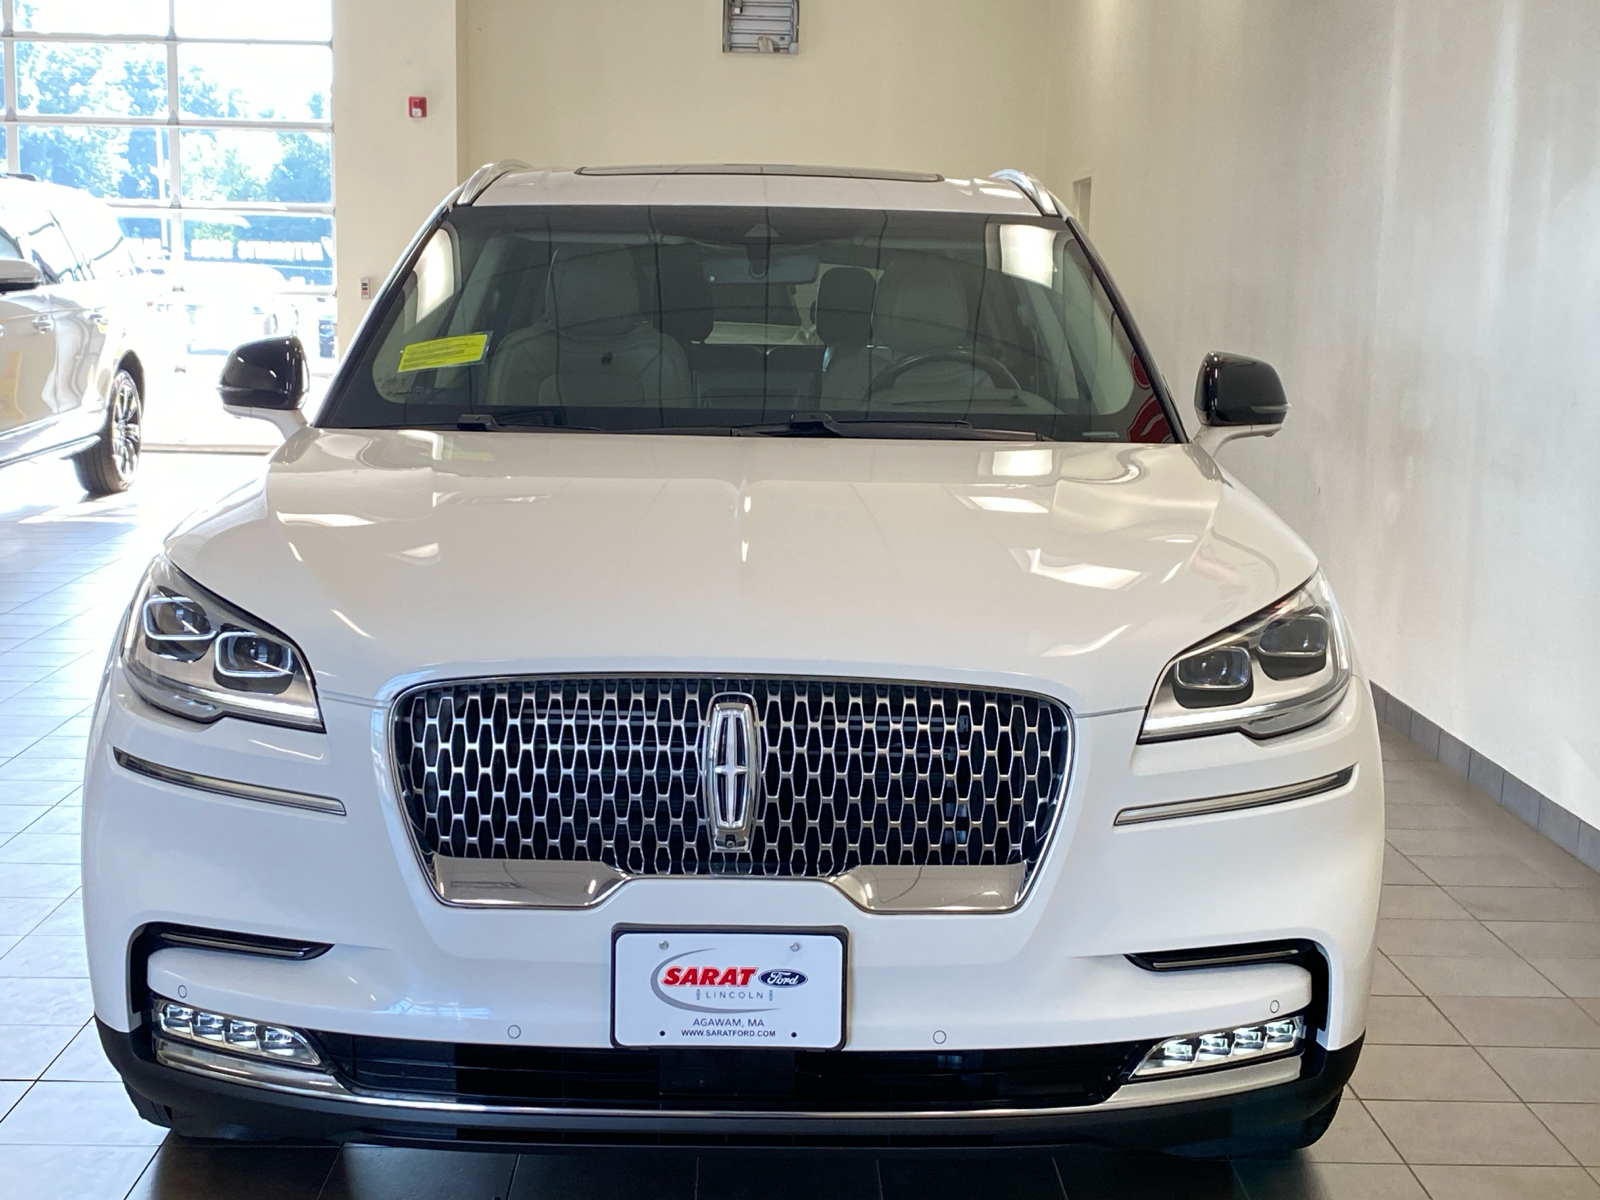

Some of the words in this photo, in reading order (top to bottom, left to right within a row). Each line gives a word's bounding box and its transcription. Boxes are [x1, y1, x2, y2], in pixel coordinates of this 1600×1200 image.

[662, 966, 758, 987] SARAT
[765, 971, 800, 986] Ford
[705, 991, 764, 999] LINCOLN
[693, 1018, 745, 1028] AGAWAM,
[747, 1018, 765, 1027] MA
[681, 1029, 776, 1037] WWW.SARATFORD.COM
